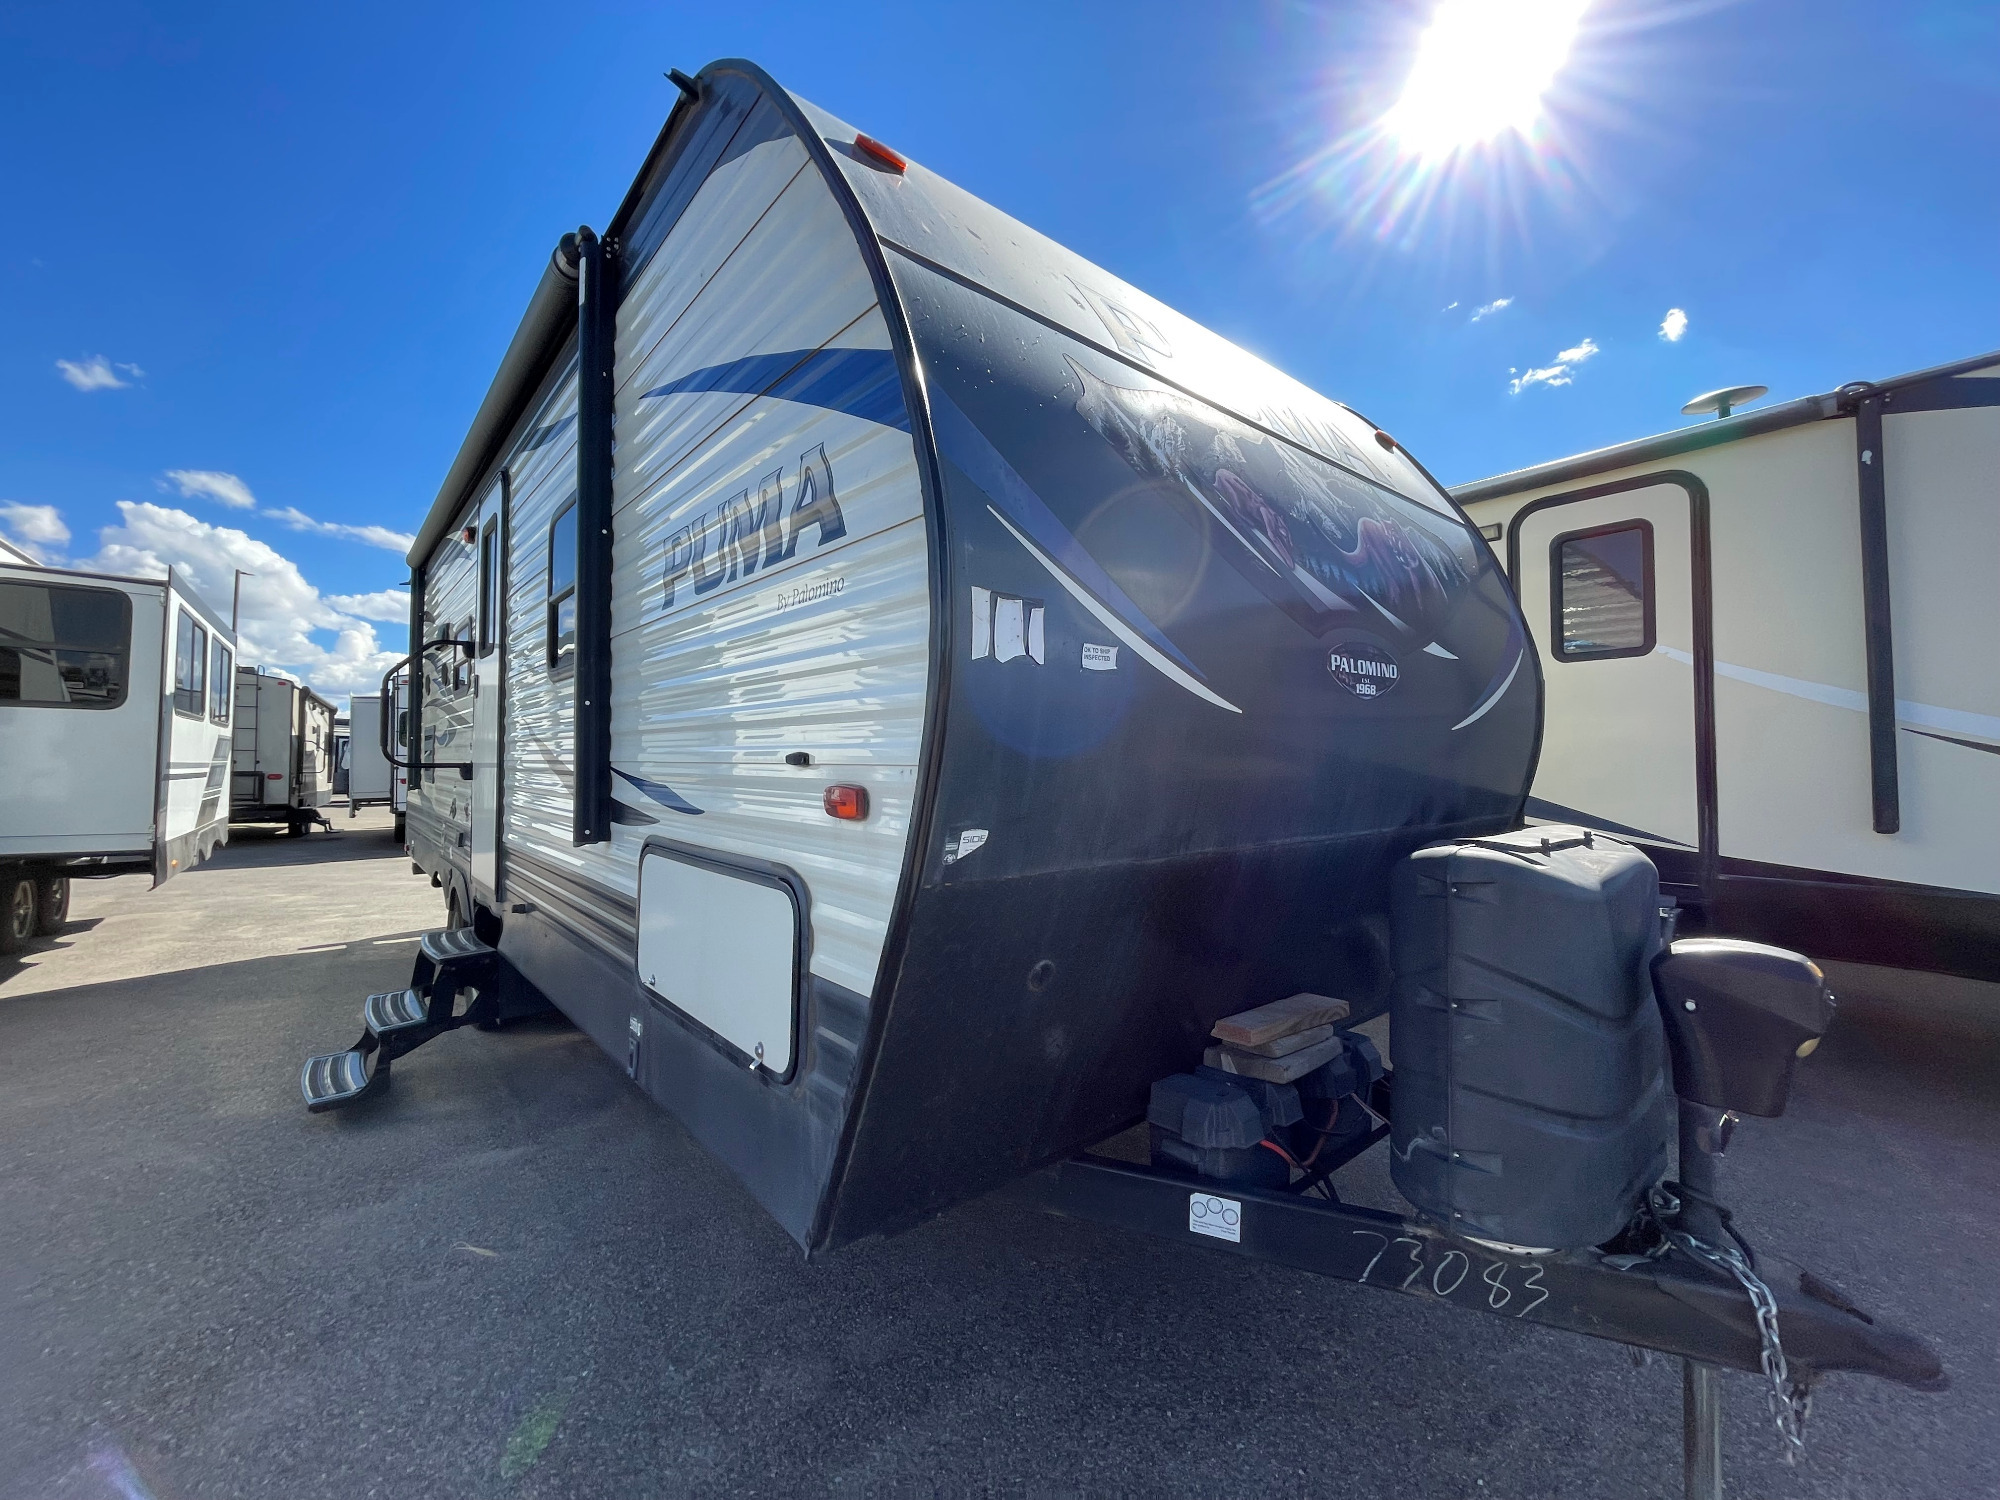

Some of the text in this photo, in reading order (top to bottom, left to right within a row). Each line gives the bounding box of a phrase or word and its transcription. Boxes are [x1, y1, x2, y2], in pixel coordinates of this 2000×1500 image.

[661, 442, 847, 611] PUMA
[777, 578, 845, 612] By Palomino
[1331, 654, 1397, 679] PALOMINO
[1356, 684, 1376, 695] 1968
[1353, 1231, 1549, 1317] 73083
